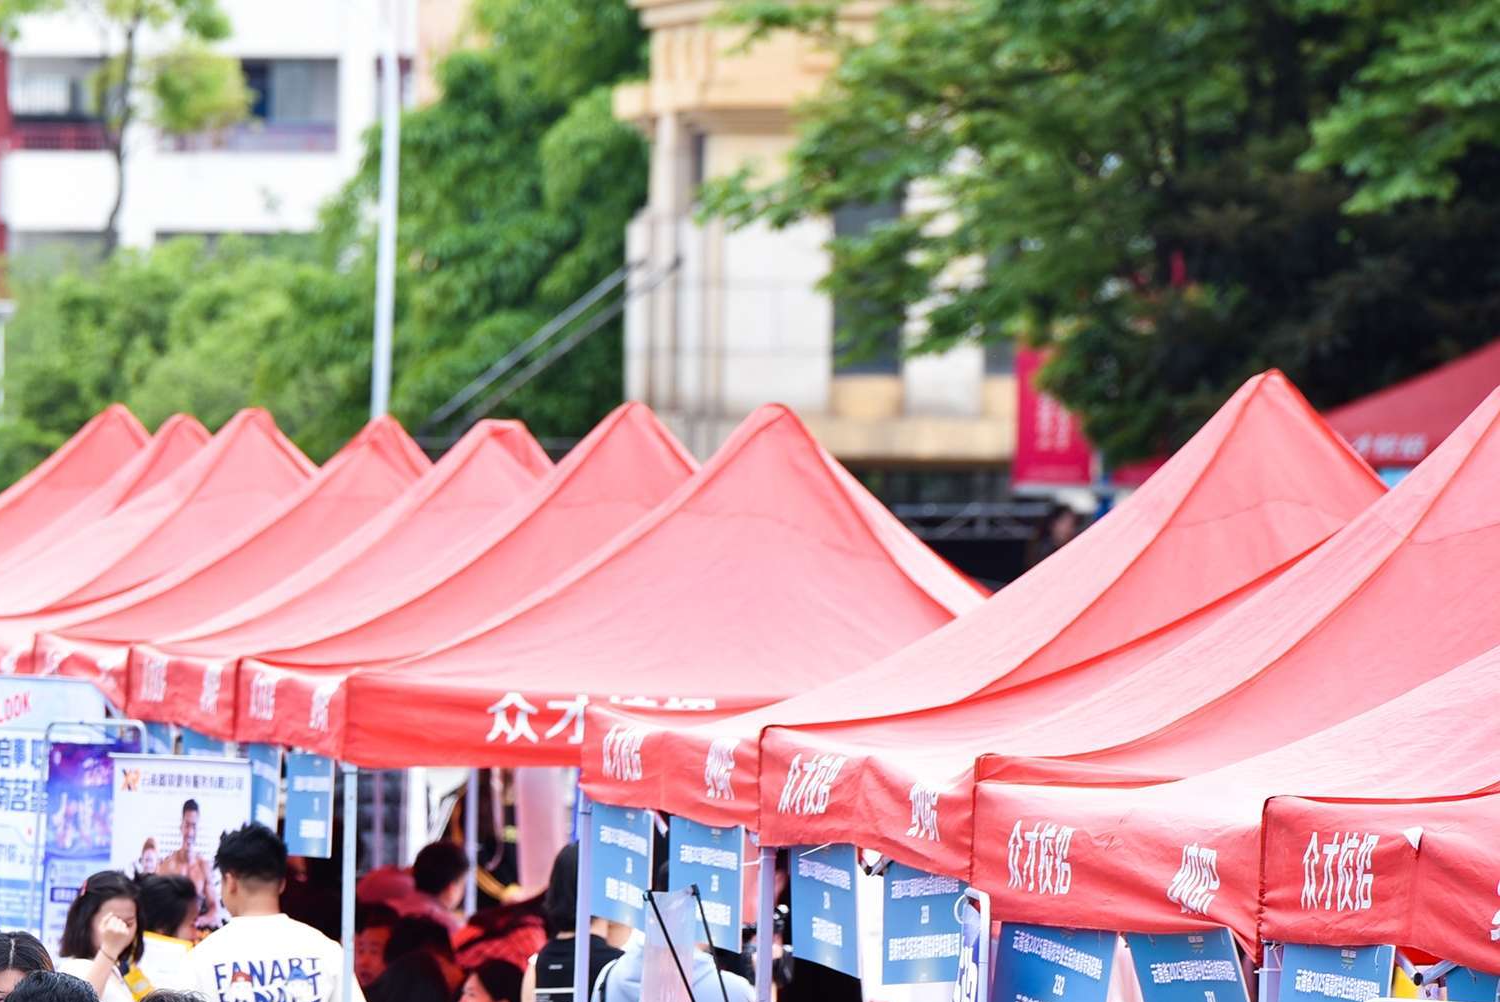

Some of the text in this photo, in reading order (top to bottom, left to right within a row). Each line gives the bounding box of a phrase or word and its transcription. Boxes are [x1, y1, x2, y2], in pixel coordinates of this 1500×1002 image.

[1007, 819, 1076, 896] 众才校招
[1300, 831, 1380, 912] 众才校招
[1052, 974, 1066, 997] 232
